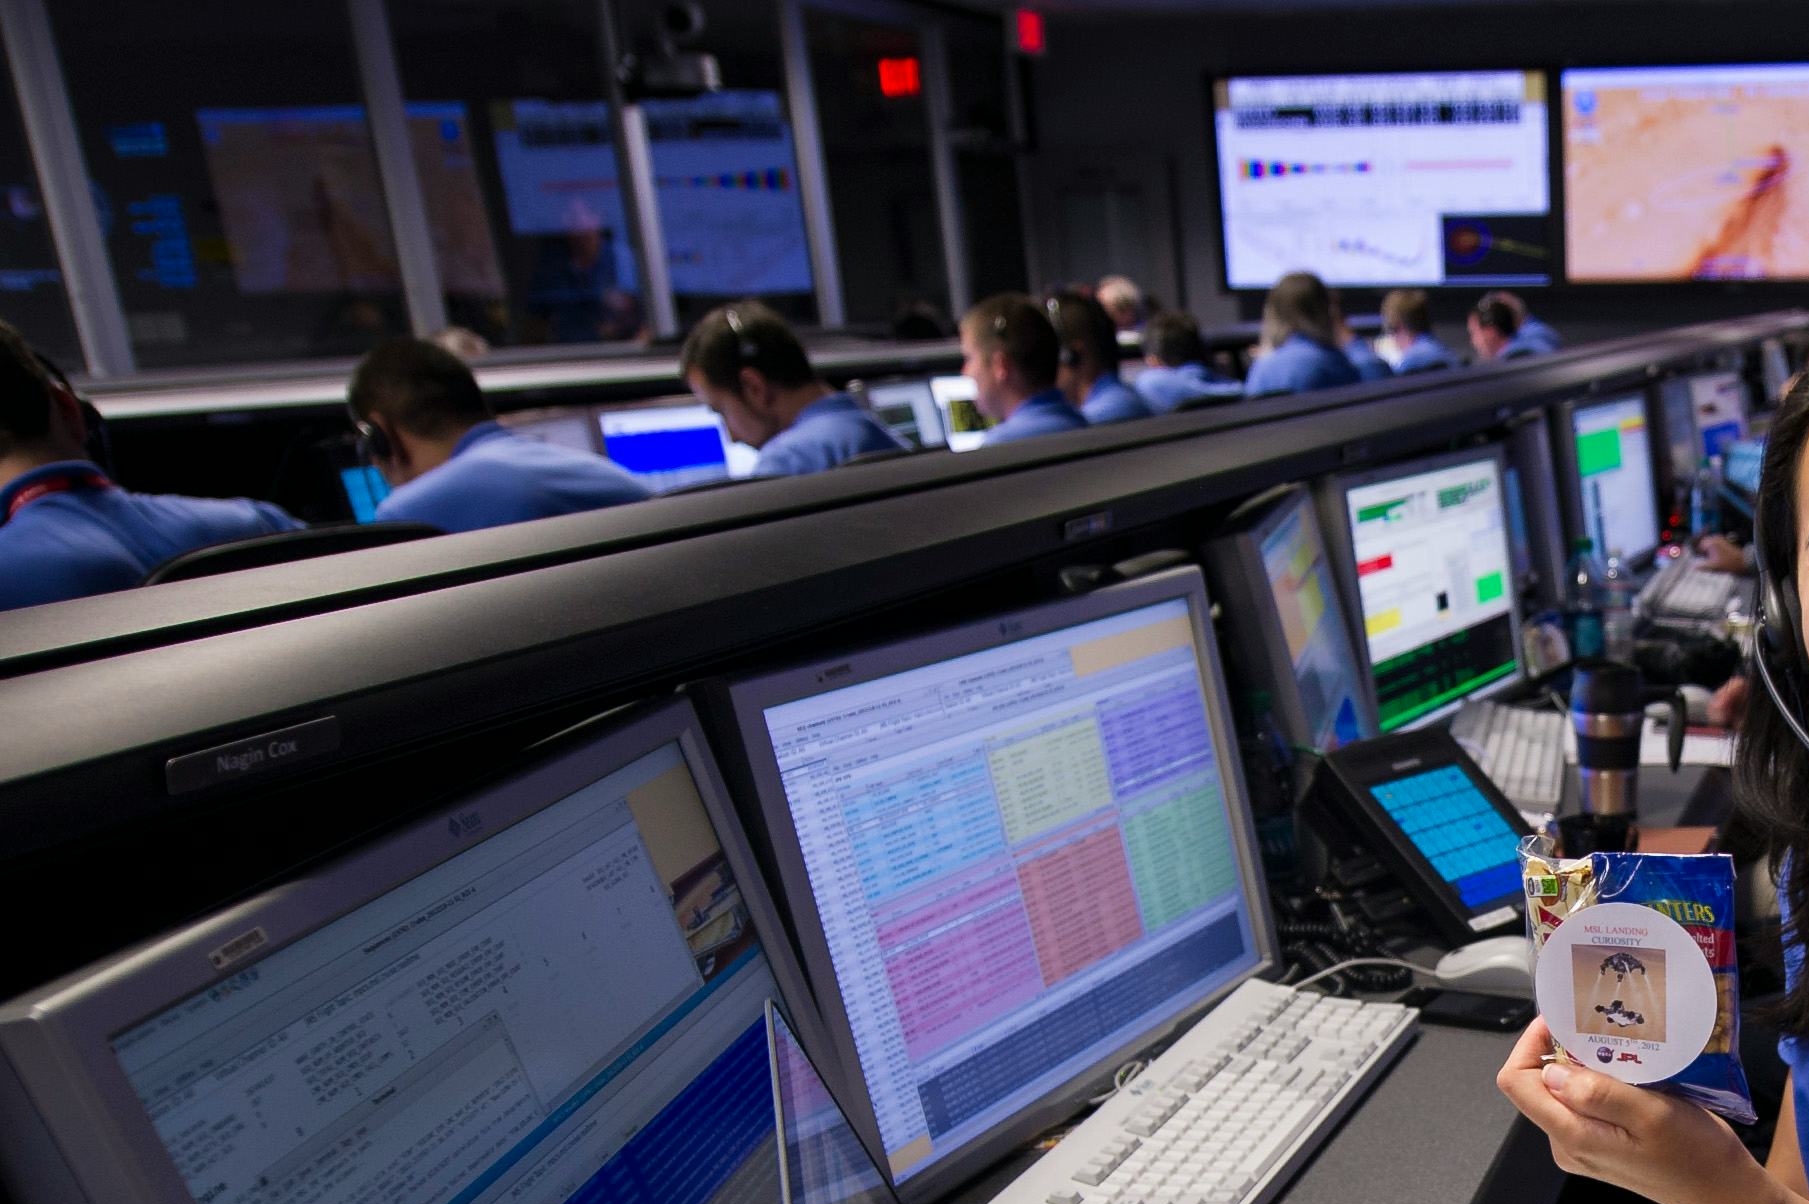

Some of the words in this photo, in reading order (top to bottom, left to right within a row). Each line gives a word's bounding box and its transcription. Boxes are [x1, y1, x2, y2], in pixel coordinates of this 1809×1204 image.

[216, 748, 264, 773] Nagin
[268, 740, 299, 759] Cox
[1648, 901, 1715, 923] NTERS
[1584, 925, 1603, 934] MSL
[1606, 926, 1648, 937] LANDING
[1591, 936, 1642, 946] CURIOSITY
[1588, 1035, 1624, 1047] AUGUST
[1617, 1053, 1642, 1064] JPL
